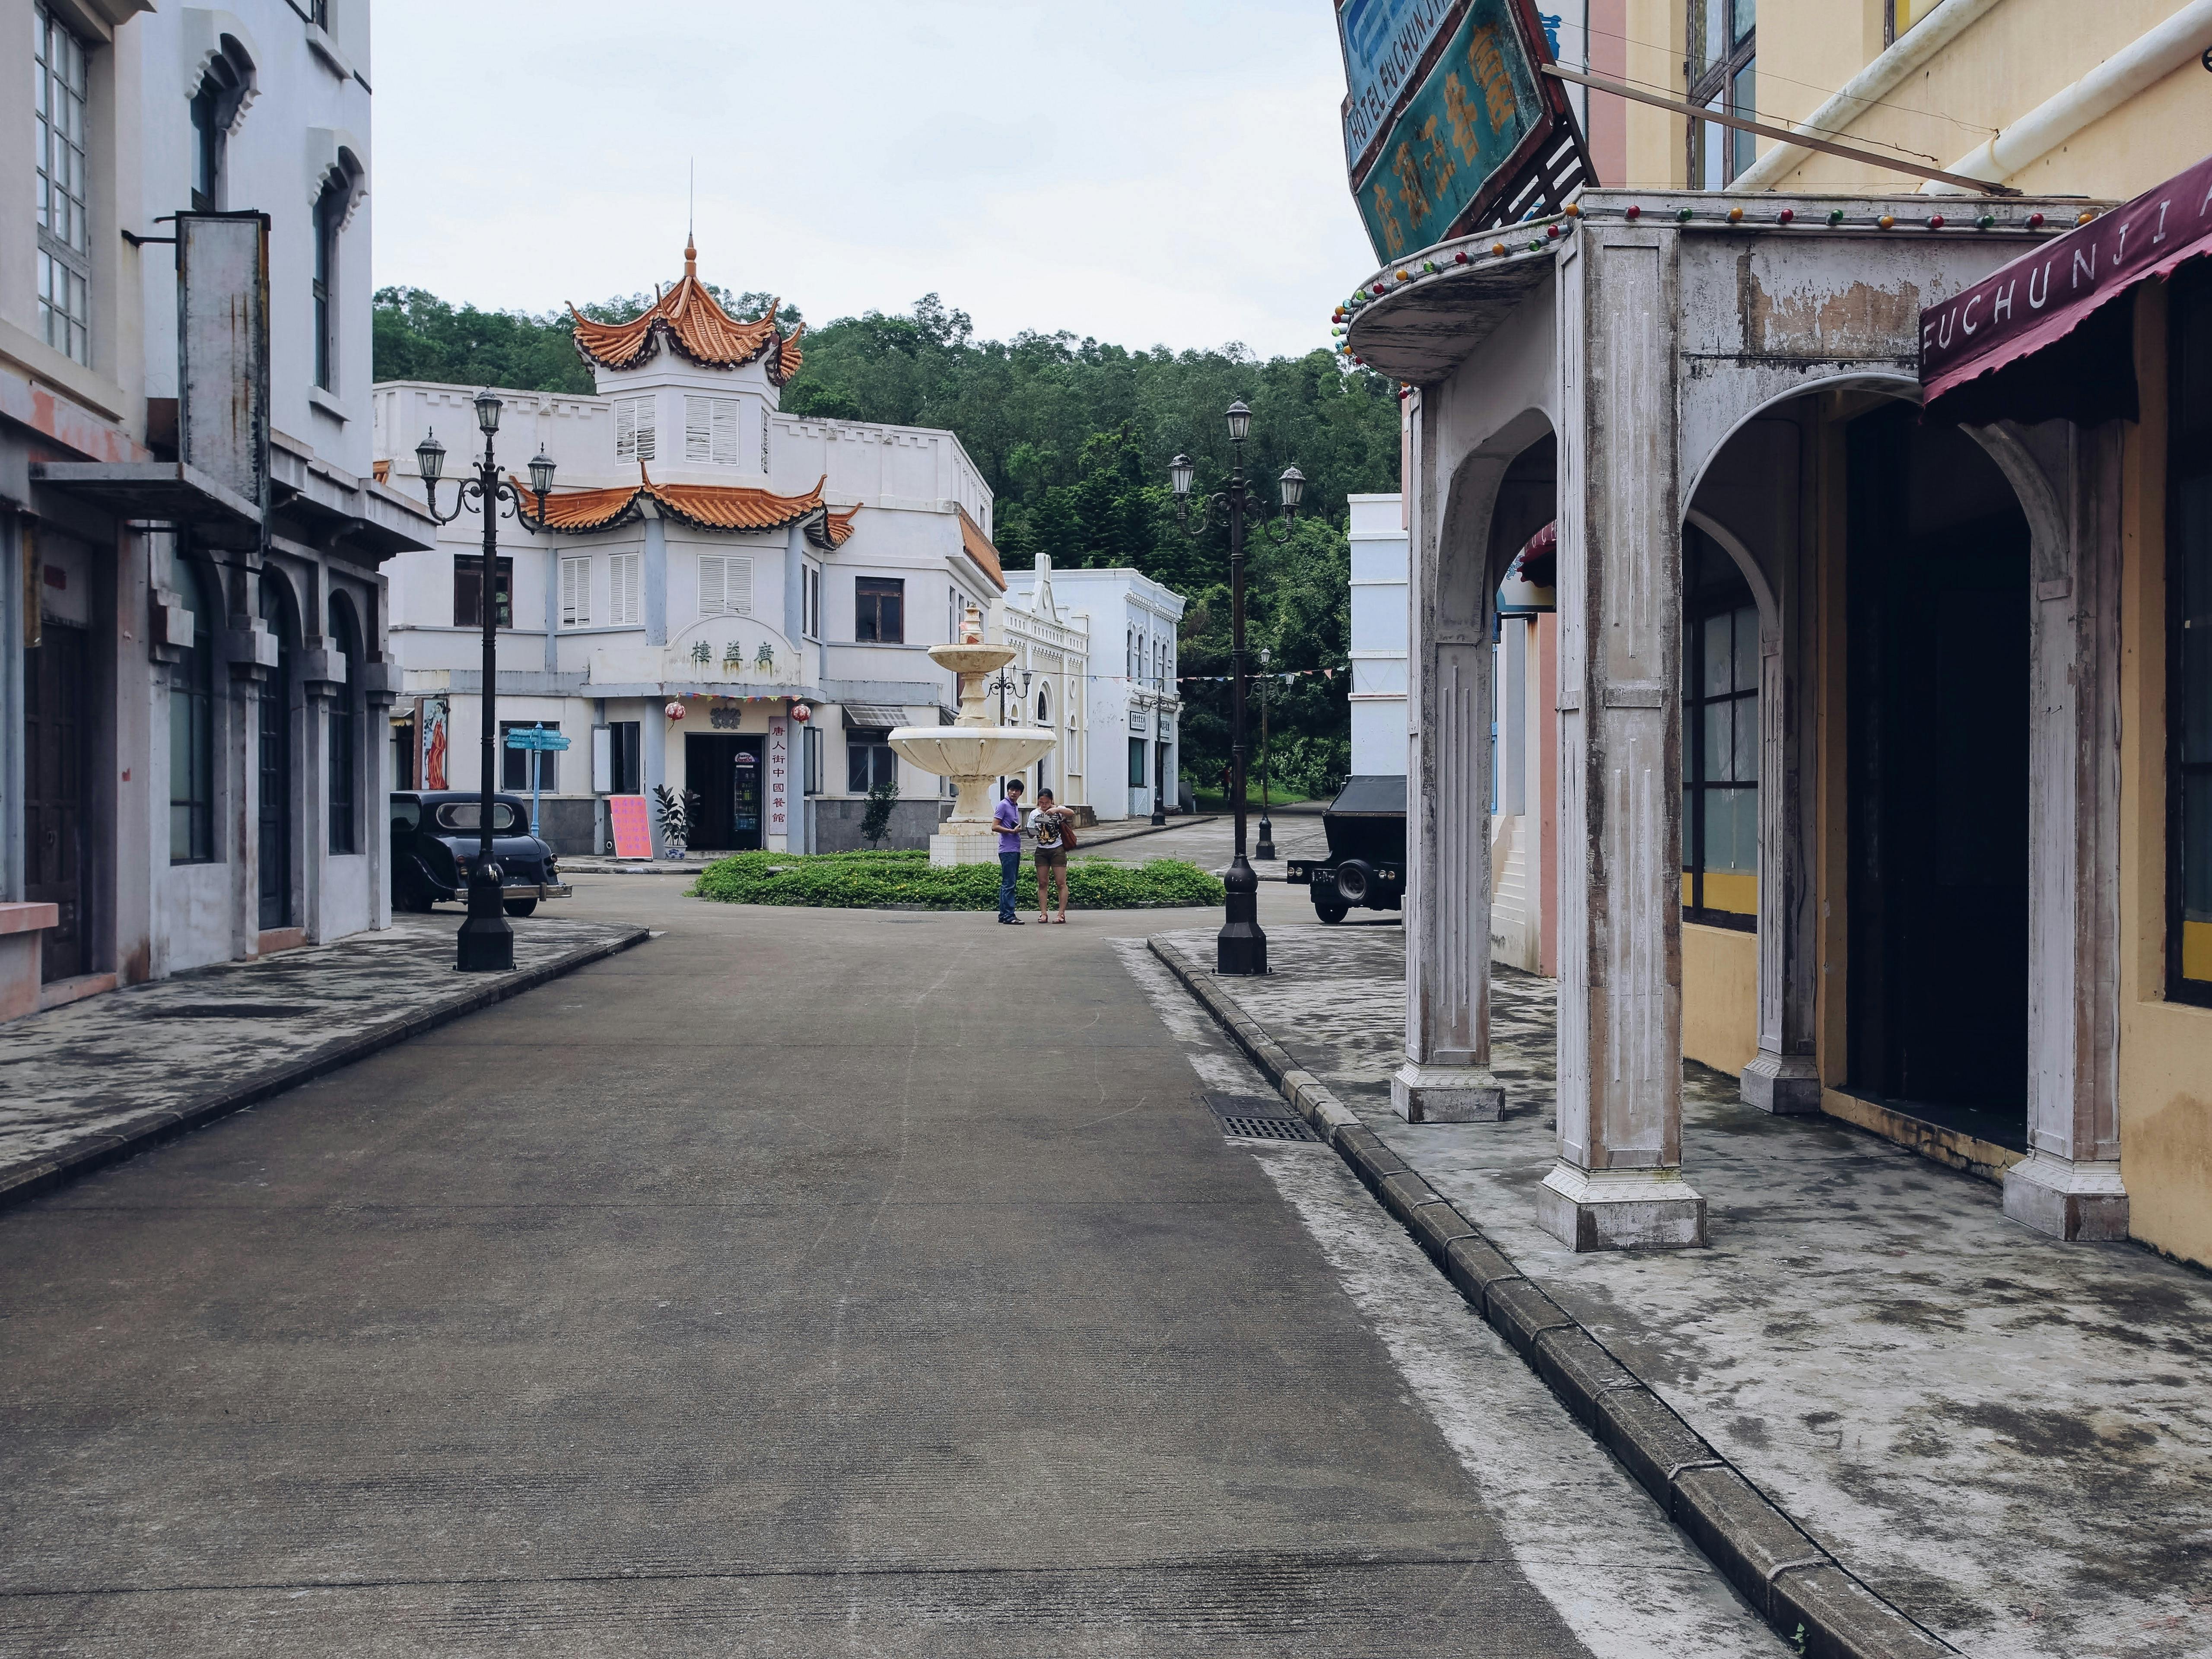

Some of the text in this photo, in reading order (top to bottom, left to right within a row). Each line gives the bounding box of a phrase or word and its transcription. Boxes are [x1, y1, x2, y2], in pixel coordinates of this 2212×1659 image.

[1349, 80, 1386, 149] HOTEL
[772, 726, 785, 822] 唐人街中國餐館
